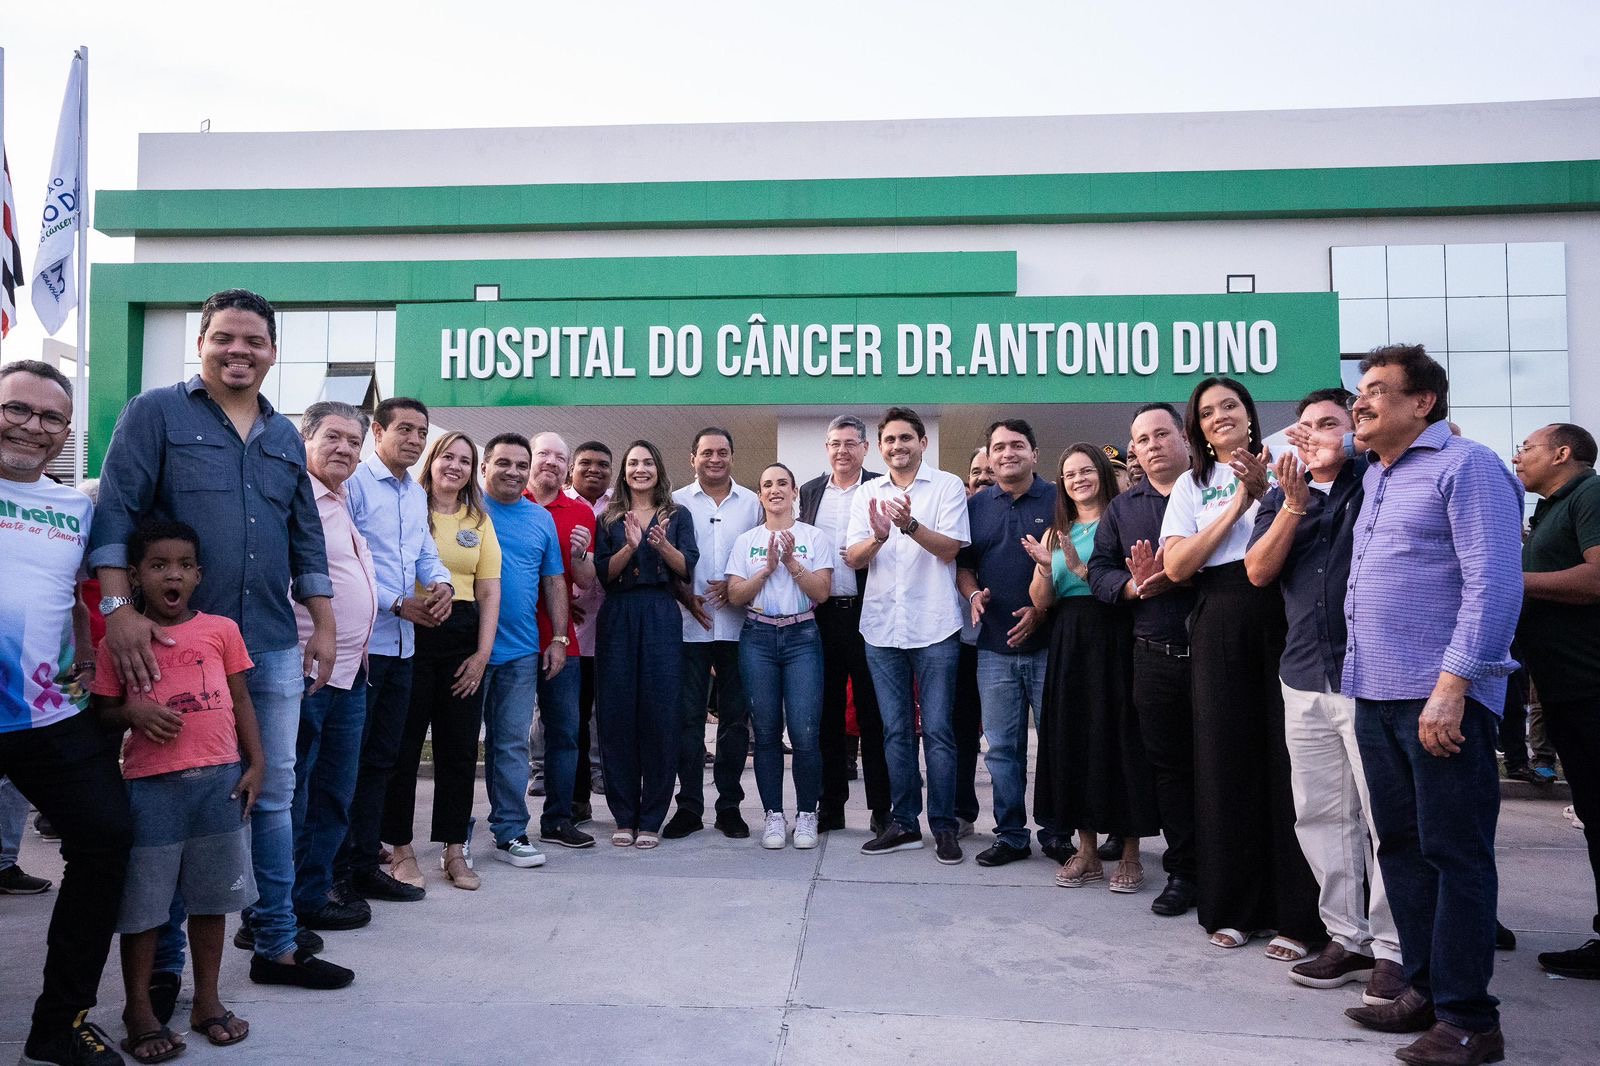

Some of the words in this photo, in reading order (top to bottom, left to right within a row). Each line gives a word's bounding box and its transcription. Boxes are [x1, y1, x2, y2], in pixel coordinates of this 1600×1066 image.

[440, 326, 637, 380] HOSPITAL
[648, 324, 703, 378] DO
[716, 313, 883, 377] CÂNCER
[1172, 319, 1279, 375] DINO
